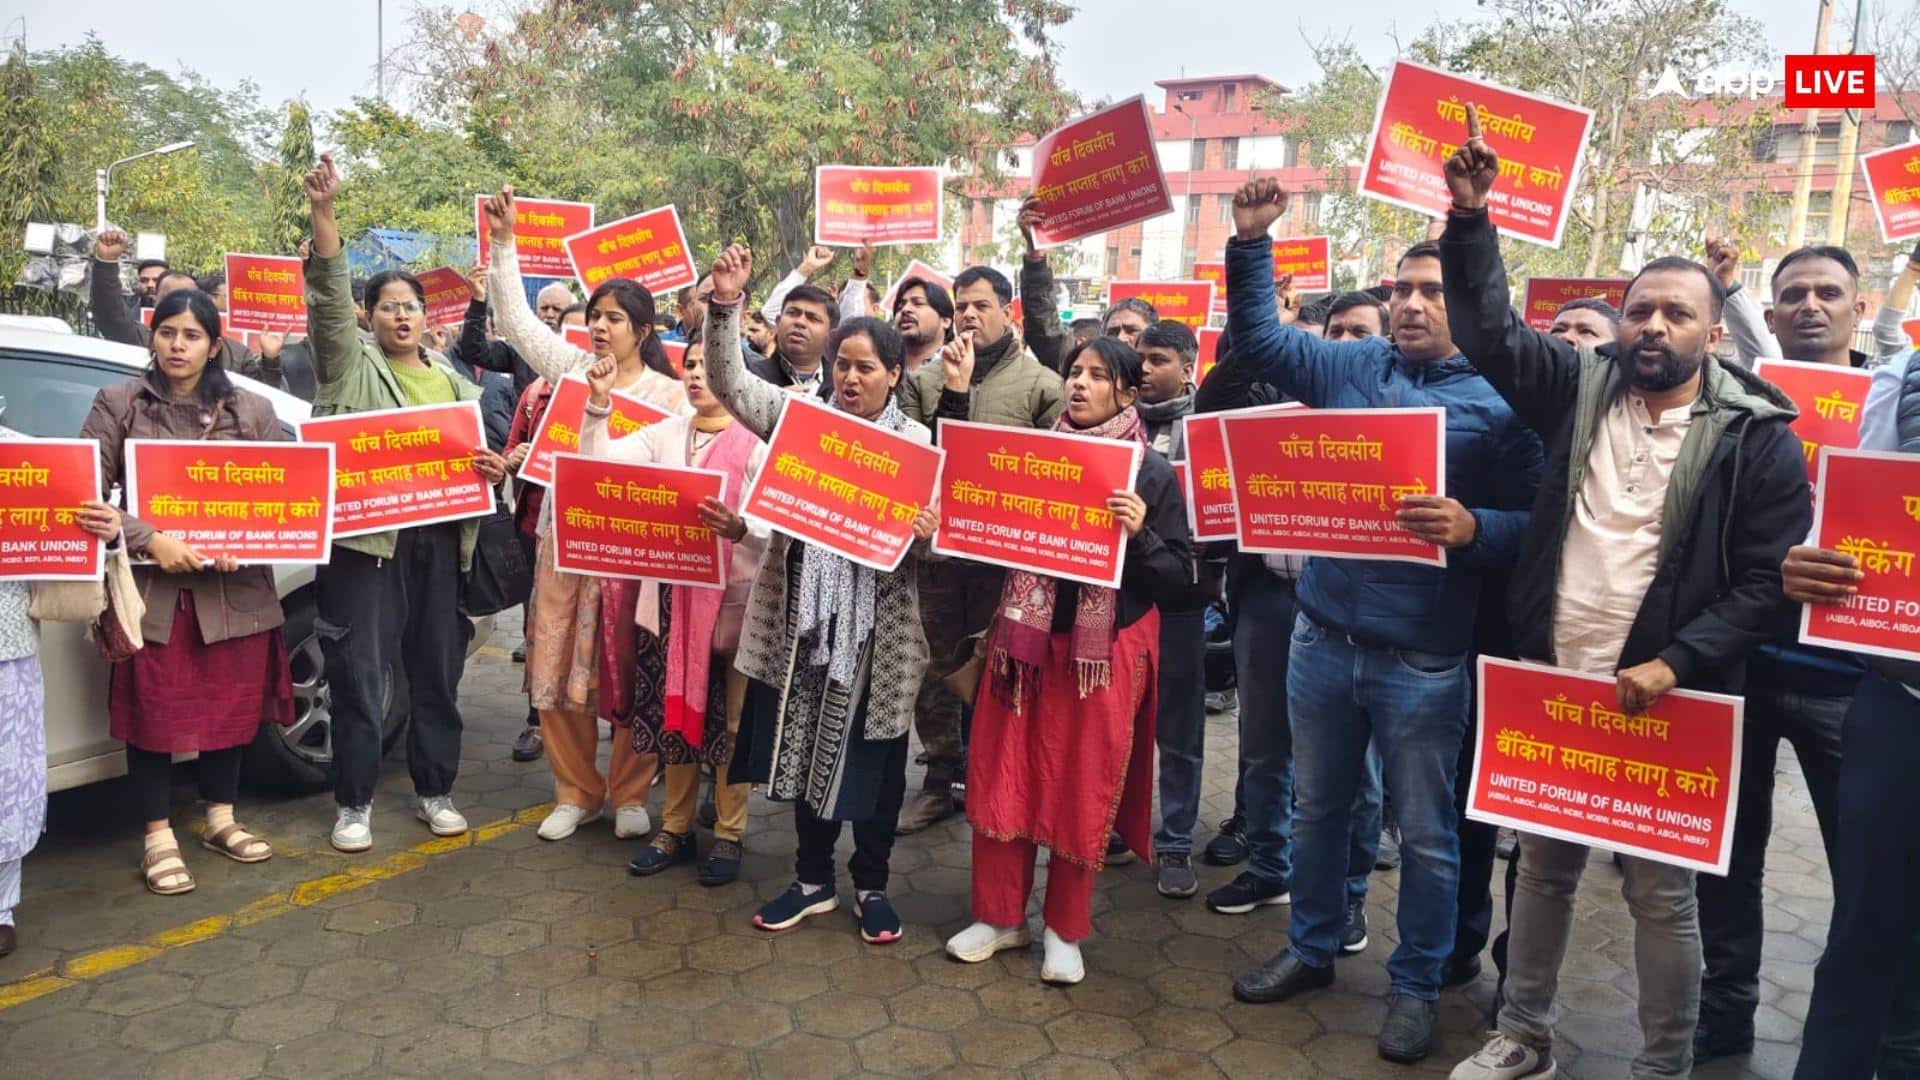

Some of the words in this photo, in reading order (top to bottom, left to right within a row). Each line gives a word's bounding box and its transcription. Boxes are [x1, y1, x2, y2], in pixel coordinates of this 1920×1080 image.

[1437, 96, 1467, 123] पाँच
[1477, 104, 1536, 144] दिवसीय
[1074, 129, 1117, 161] दिवसीय
[1390, 122, 1437, 157] बैंकिंग
[1531, 164, 1563, 190] करो
[1068, 172, 1100, 195] सप्ताह
[1101, 163, 1126, 184] लागू
[1126, 152, 1150, 174] करो
[1380, 159, 1419, 182] UNITED
[1487, 191, 1509, 205] ANK
[1510, 195, 1553, 216] UNIONS
[1094, 201, 1104, 213] OF
[1128, 184, 1157, 201] UNIONS
[1815, 390, 1859, 424] पाँच
[350, 431, 381, 453] पाँच
[386, 425, 441, 452] दिवसीय
[820, 431, 848, 457] पाँच
[852, 441, 900, 478] दिवसीय
[1278, 432, 1314, 459] पाँच
[1320, 433, 1383, 463] दिवसीय
[0, 461, 49, 487] वसीय
[187, 459, 219, 483] पाँच
[226, 462, 285, 486] दिवसीय
[337, 469, 366, 490] किंग
[371, 465, 413, 484] सप्ताह
[416, 460, 449, 481] लागू
[989, 446, 1020, 475] पाँच
[1025, 452, 1084, 484] दिवसीय
[1200, 467, 1232, 490] बैंकिं
[335, 501, 361, 513] NITED
[364, 498, 399, 510] FORUM
[401, 494, 414, 502] OF
[416, 488, 443, 500] BANK
[445, 483, 480, 497] UNIONS
[595, 475, 623, 501] पाँच
[628, 481, 679, 507] दिवसीय
[775, 452, 817, 487] बैंकिंग
[819, 472, 859, 502] सप्ताह
[860, 488, 890, 522] लागू
[1247, 473, 1296, 500] बैंकिंग
[1301, 480, 1347, 504] सप्ताह
[1351, 483, 1391, 512] लागू
[10, 507, 50, 531] लागू
[150, 493, 199, 517] बैंकिंग
[204, 501, 249, 520] सप्ताह
[254, 502, 287, 524] लागू
[290, 497, 321, 518] करो
[762, 486, 795, 503] UNITED
[796, 497, 829, 518] FORUM
[830, 510, 844, 523] OF
[844, 516, 873, 536] BANK
[952, 479, 998, 509] बैंकिंग
[1002, 493, 1046, 519] सप्ताह
[1049, 499, 1081, 530] लागू
[1203, 504, 1235, 515] UNITED
[188, 530, 226, 540] FORUM
[229, 530, 243, 540] OF
[246, 530, 275, 540] BANK
[279, 530, 317, 540] UNIONS
[565, 505, 605, 530] बैंकिंग
[611, 516, 648, 540] सप्ताह
[652, 523, 683, 546] लागू
[948, 516, 984, 533] UNITED
[986, 524, 1021, 540] FORUM
[1023, 529, 1038, 542] OF
[1039, 532, 1068, 547] BANK
[1070, 539, 1110, 556] UNIONS
[1249, 513, 1289, 525] UNITED
[1291, 515, 1328, 527] FORUM
[1331, 517, 1346, 529] OF
[1349, 518, 1380, 531] BANK
[2, 542, 36, 552] BANK
[41, 541, 88, 551] UNIONS
[566, 540, 597, 552] UNITED
[600, 543, 632, 556] FORUM
[634, 547, 646, 557] OF
[649, 549, 675, 560] BANK
[677, 552, 712, 564] UNIONS
[1840, 593, 1891, 614] NITED
[1826, 613, 1858, 626] (AIBEA,
[1860, 618, 1890, 630] AIBOC,
[1543, 693, 1584, 726] पाँच
[1496, 727, 1554, 766] बैंकिंग
[1561, 746, 1620, 783] सप्ताह
[1624, 758, 1669, 798] लागू
[1675, 766, 1720, 799] करो
[1489, 772, 1537, 795] UNITED
[1539, 783, 1588, 805] FORUM
[1590, 791, 1610, 809] OF
[1612, 799, 1653, 820] BANK
[1656, 807, 1712, 833] UNIONS
